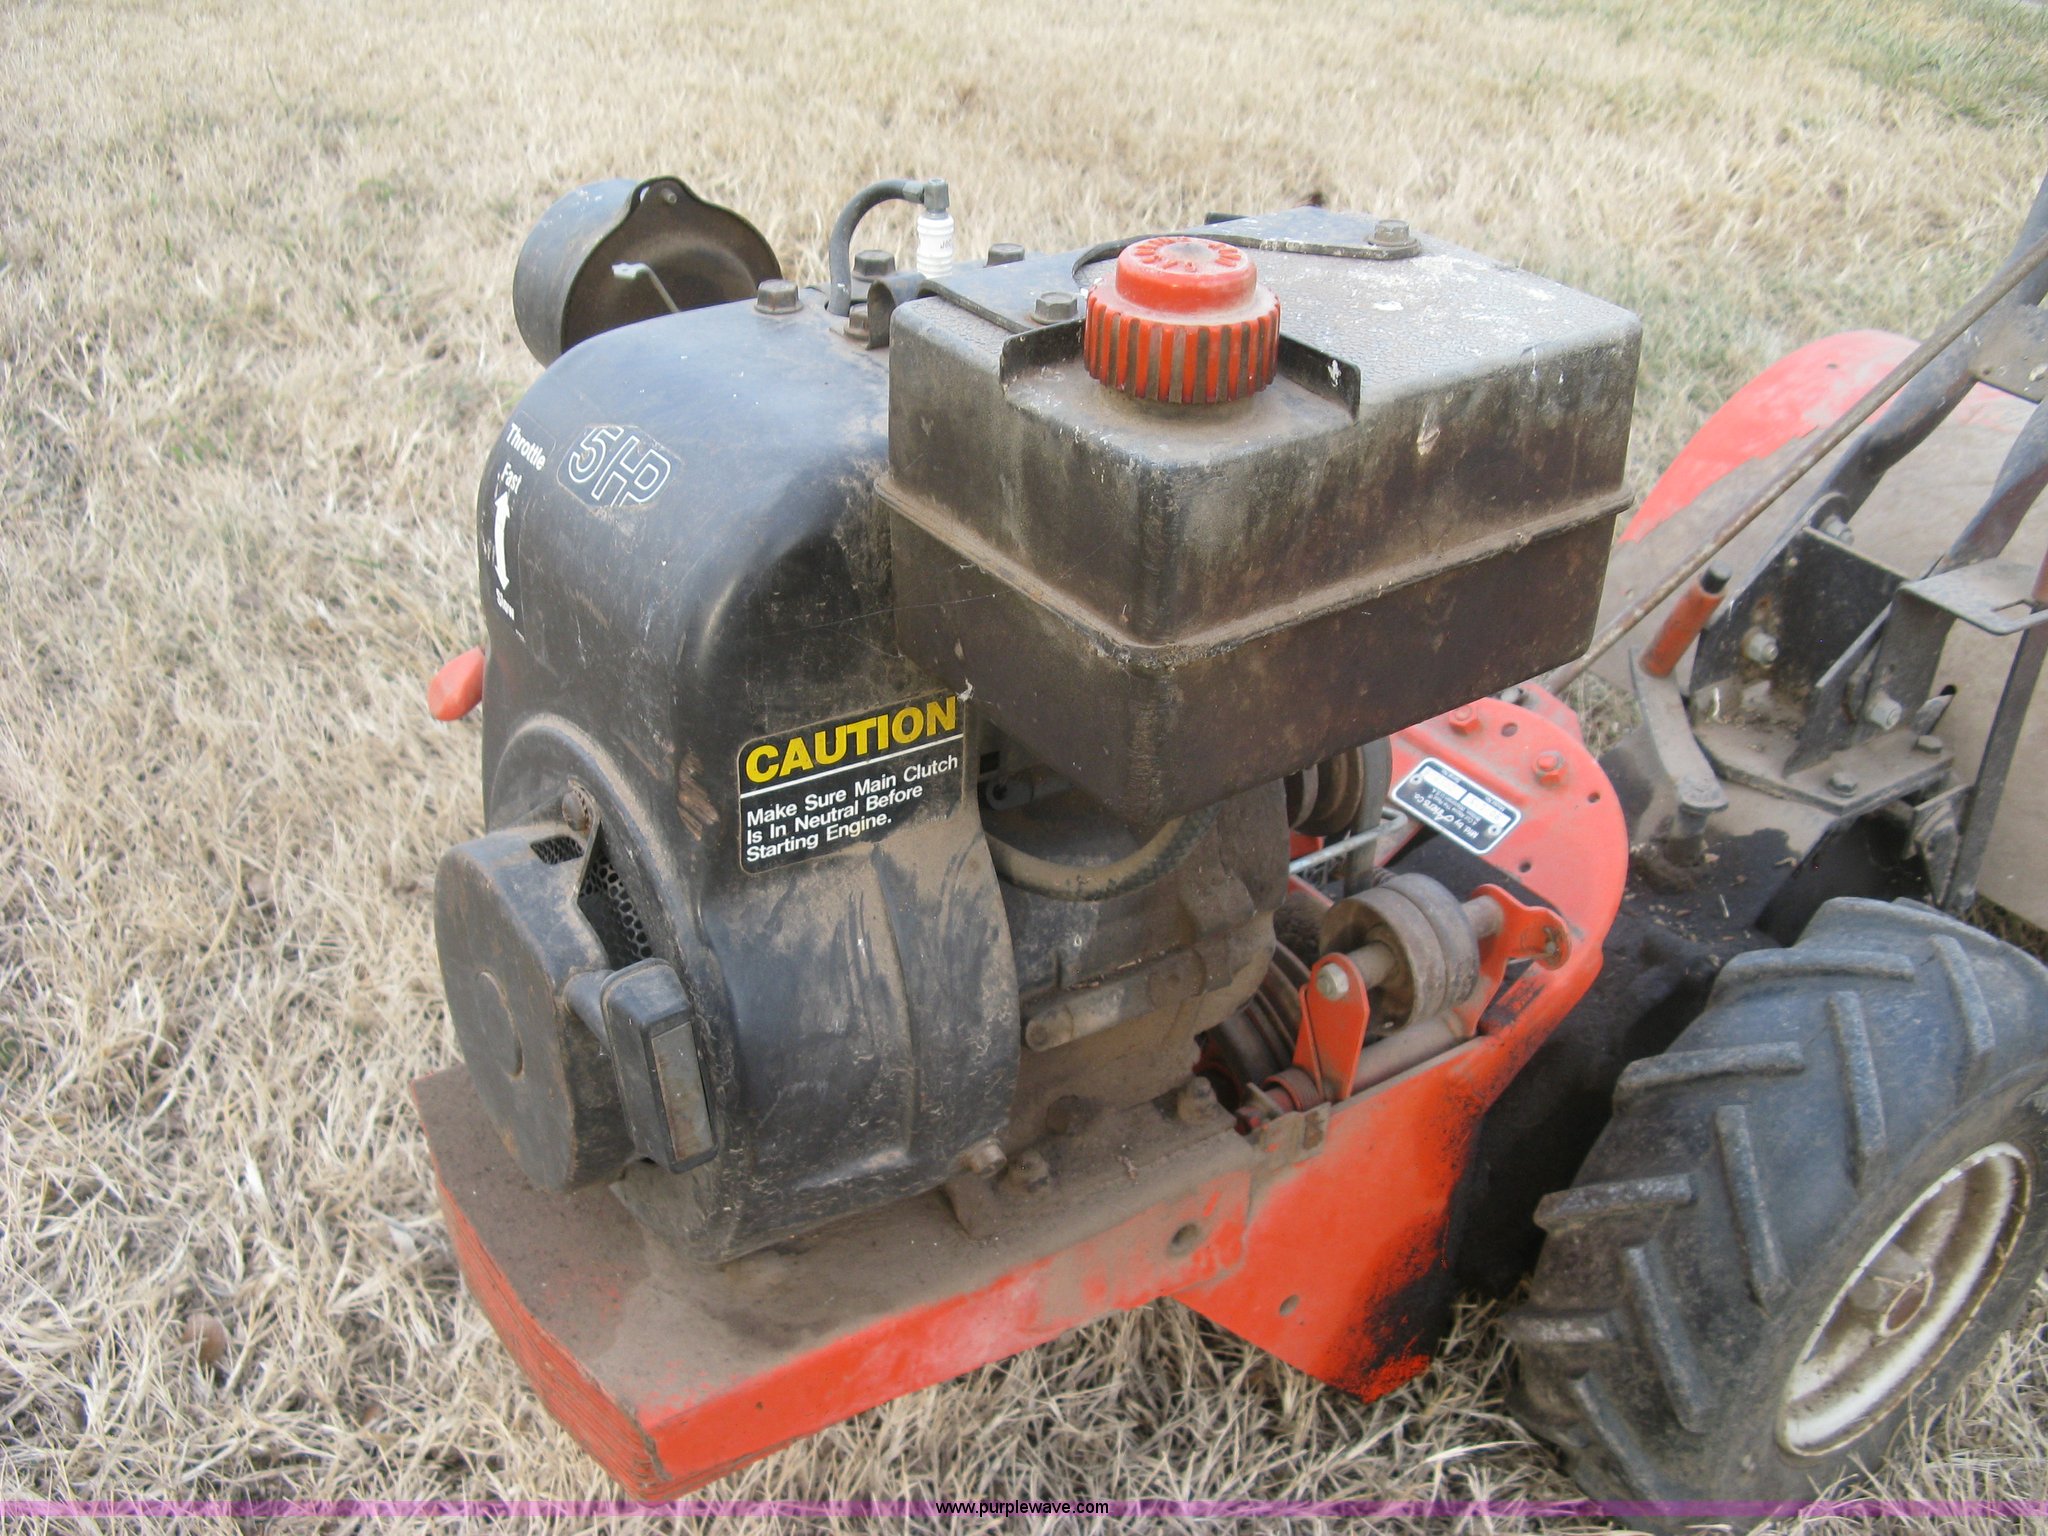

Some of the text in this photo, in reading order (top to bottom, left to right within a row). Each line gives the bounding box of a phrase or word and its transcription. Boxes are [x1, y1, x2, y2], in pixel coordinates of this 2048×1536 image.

[506, 422, 546, 471] Throttle
[568, 427, 671, 507] 5HP
[500, 462, 522, 494] Fast
[745, 696, 957, 783] CAUTION
[746, 754, 958, 827] Make Sure Main Clutch
[746, 785, 923, 845] Is In Neutral Before
[746, 811, 892, 862] Starting Engine.
